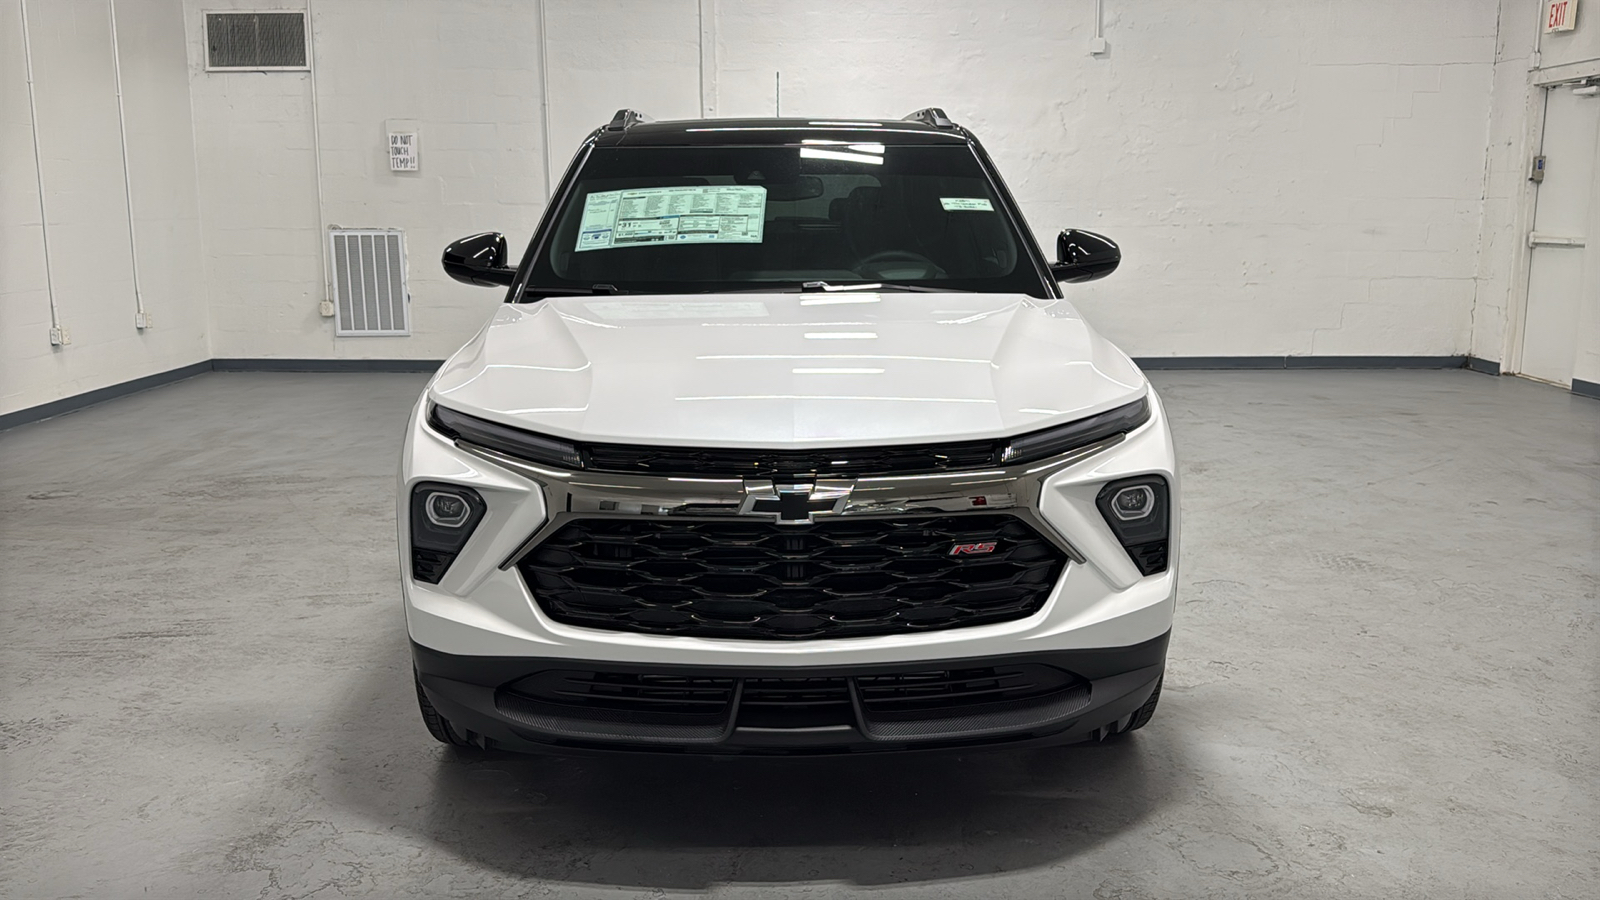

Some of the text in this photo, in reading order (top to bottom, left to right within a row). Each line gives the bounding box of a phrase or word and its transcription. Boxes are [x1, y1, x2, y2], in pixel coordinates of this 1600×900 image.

[1549, 1, 1567, 28] EXIT
[391, 134, 413, 146] DO NOT
[391, 146, 409, 156] TOUCH
[392, 156, 416, 169] TEMP!!
[949, 542, 997, 555] RS
